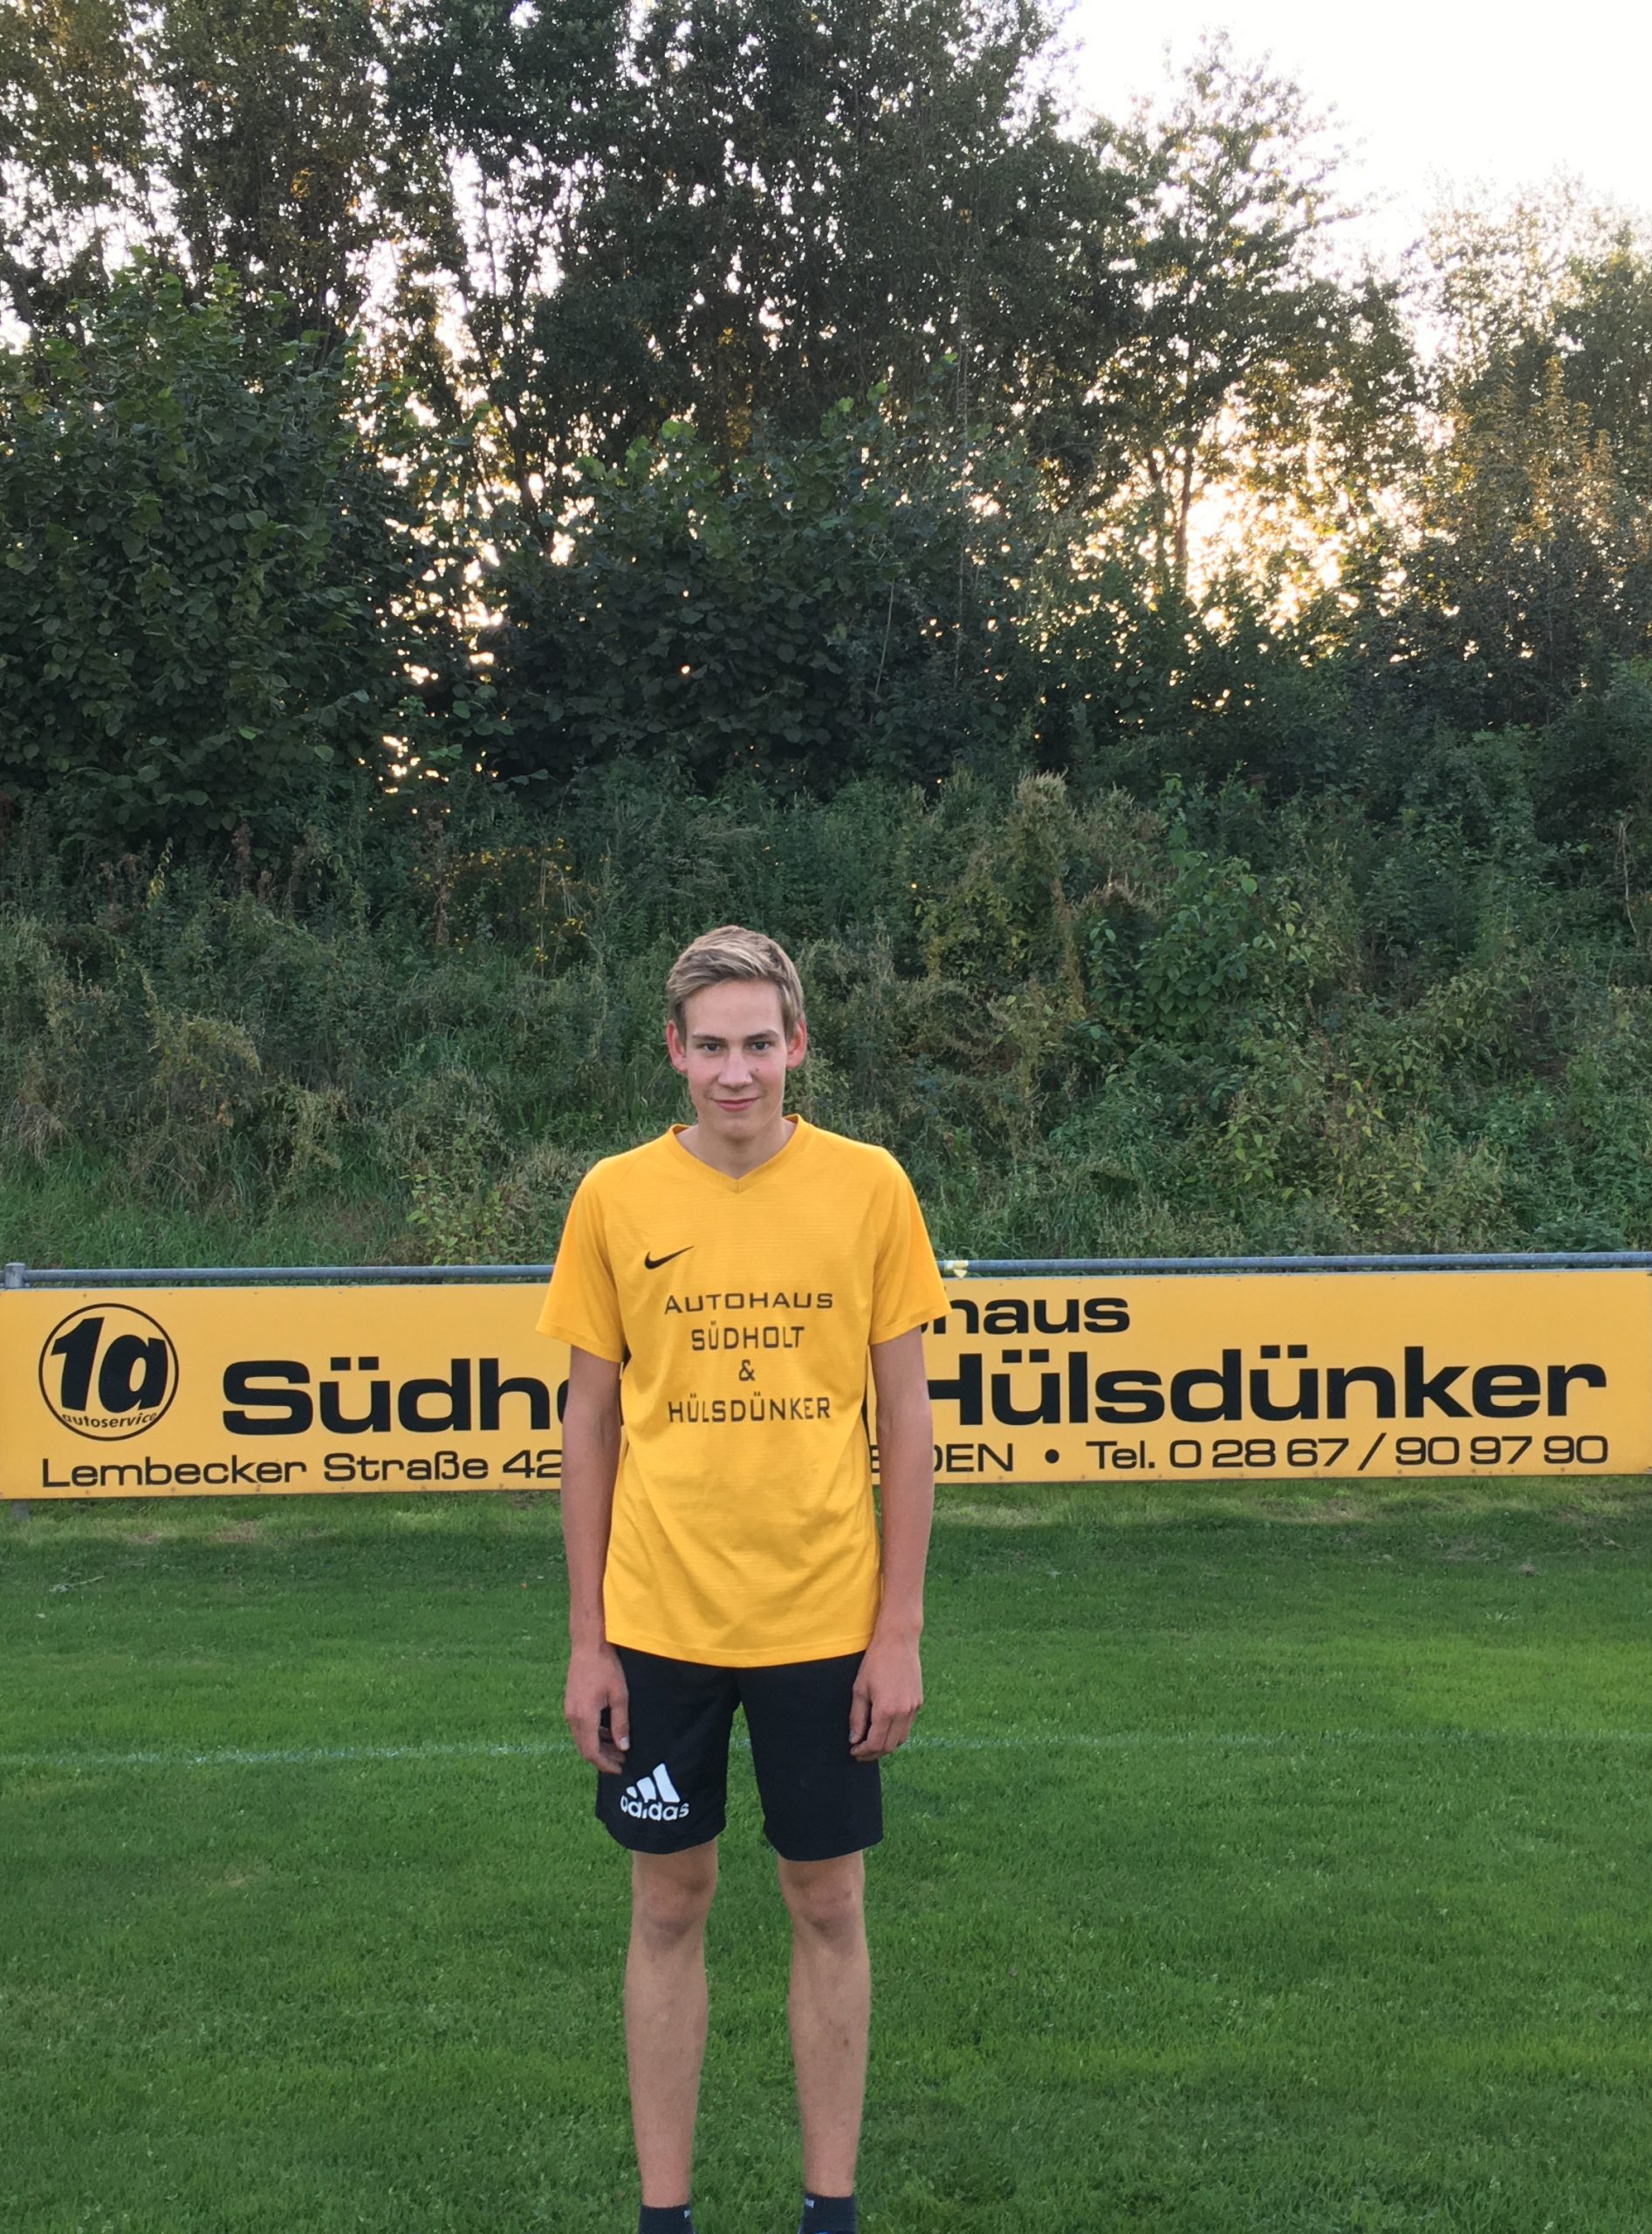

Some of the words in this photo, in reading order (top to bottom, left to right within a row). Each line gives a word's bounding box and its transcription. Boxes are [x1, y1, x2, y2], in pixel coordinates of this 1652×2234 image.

[664, 1292, 833, 1315] AUTOHAUS
[921, 1297, 1130, 1335] haus
[690, 1320, 805, 1351] SÜDHOLT
[51, 1316, 168, 1414] 1a
[738, 1359, 756, 1381] &
[223, 1356, 570, 1436] Südh
[927, 1344, 1607, 1427] Hülsdünker
[61, 1412, 157, 1429] autoservice
[668, 1391, 831, 1423] HÜLSDÜNKER
[42, 1455, 306, 1488] Lembecker
[324, 1451, 489, 1483] Straße
[1086, 1440, 1155, 1470] Tel.
[620, 1795, 689, 1821] adidas
